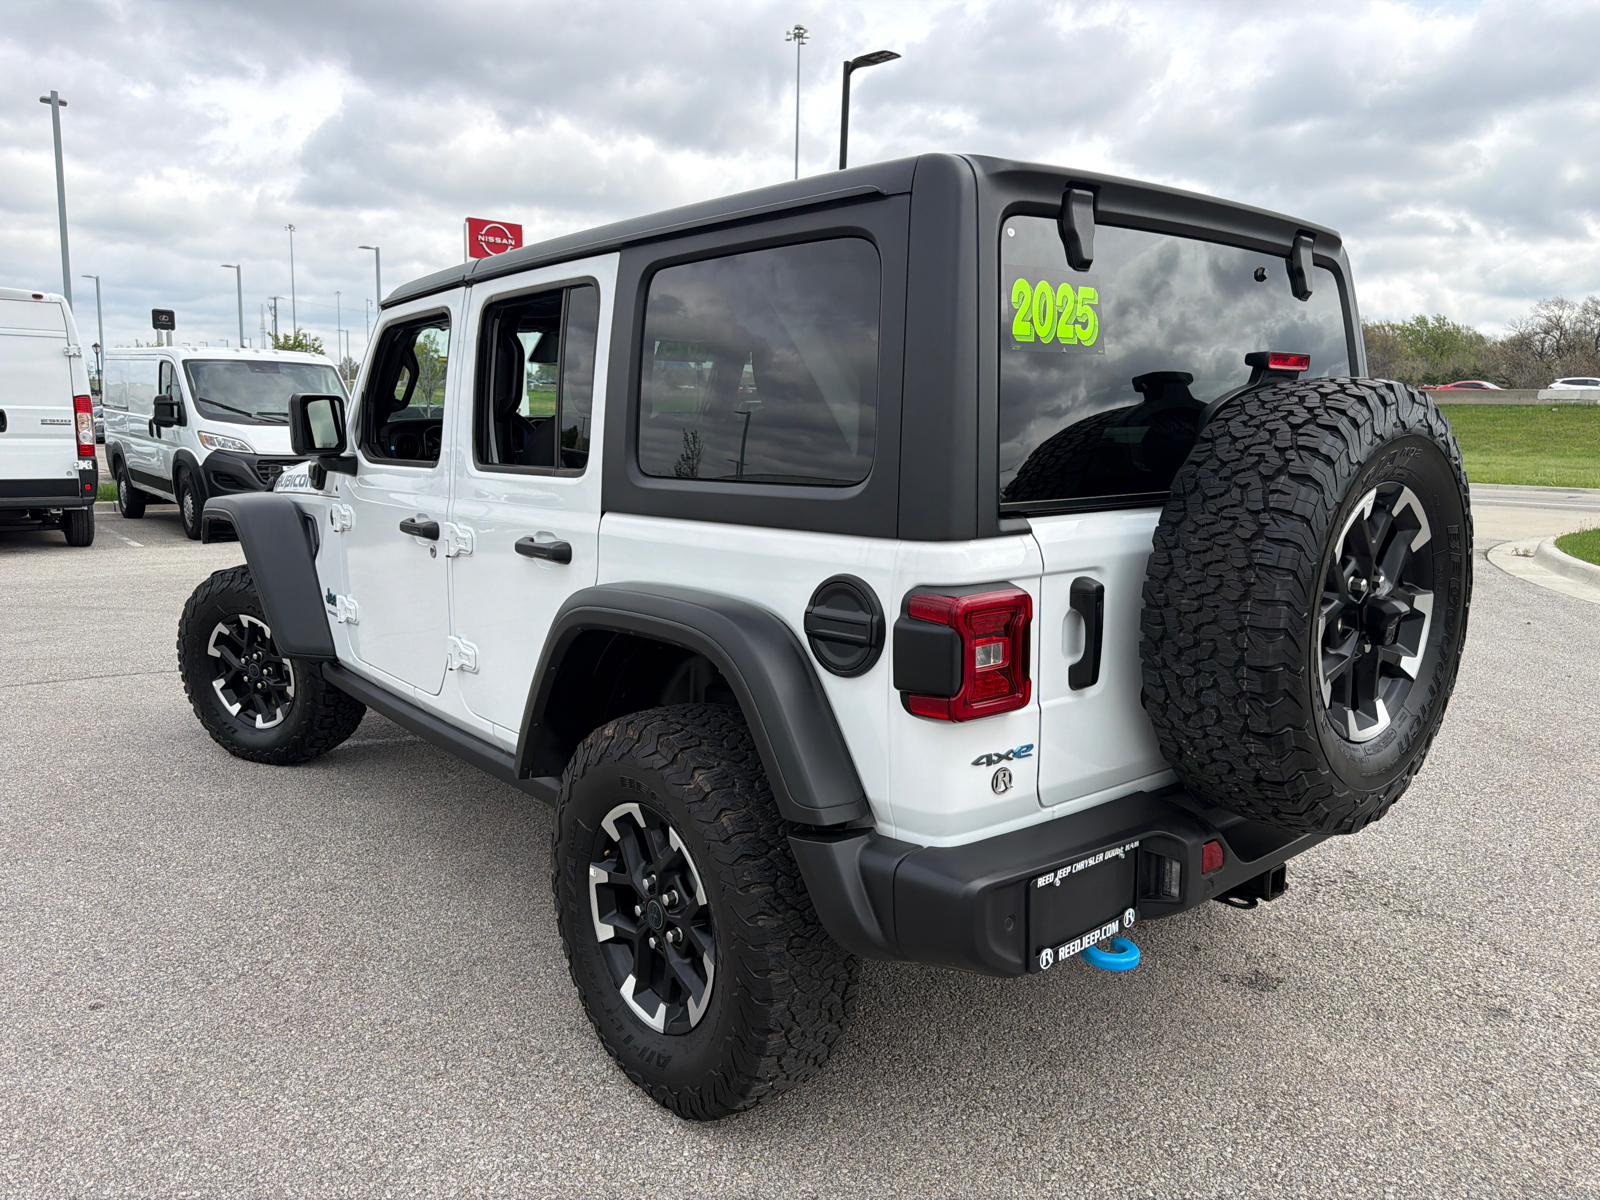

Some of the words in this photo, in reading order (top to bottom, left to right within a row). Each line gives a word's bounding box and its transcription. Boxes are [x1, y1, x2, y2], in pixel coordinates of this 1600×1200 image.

[478, 234, 515, 246] NISSAN
[1011, 277, 1099, 347] 2025
[1037, 872, 1055, 888] REED
[1055, 866, 1072, 880] JEEP
[1072, 852, 1104, 874] CHRYSLER
[1058, 919, 1119, 961] REEDJEEP.COM
